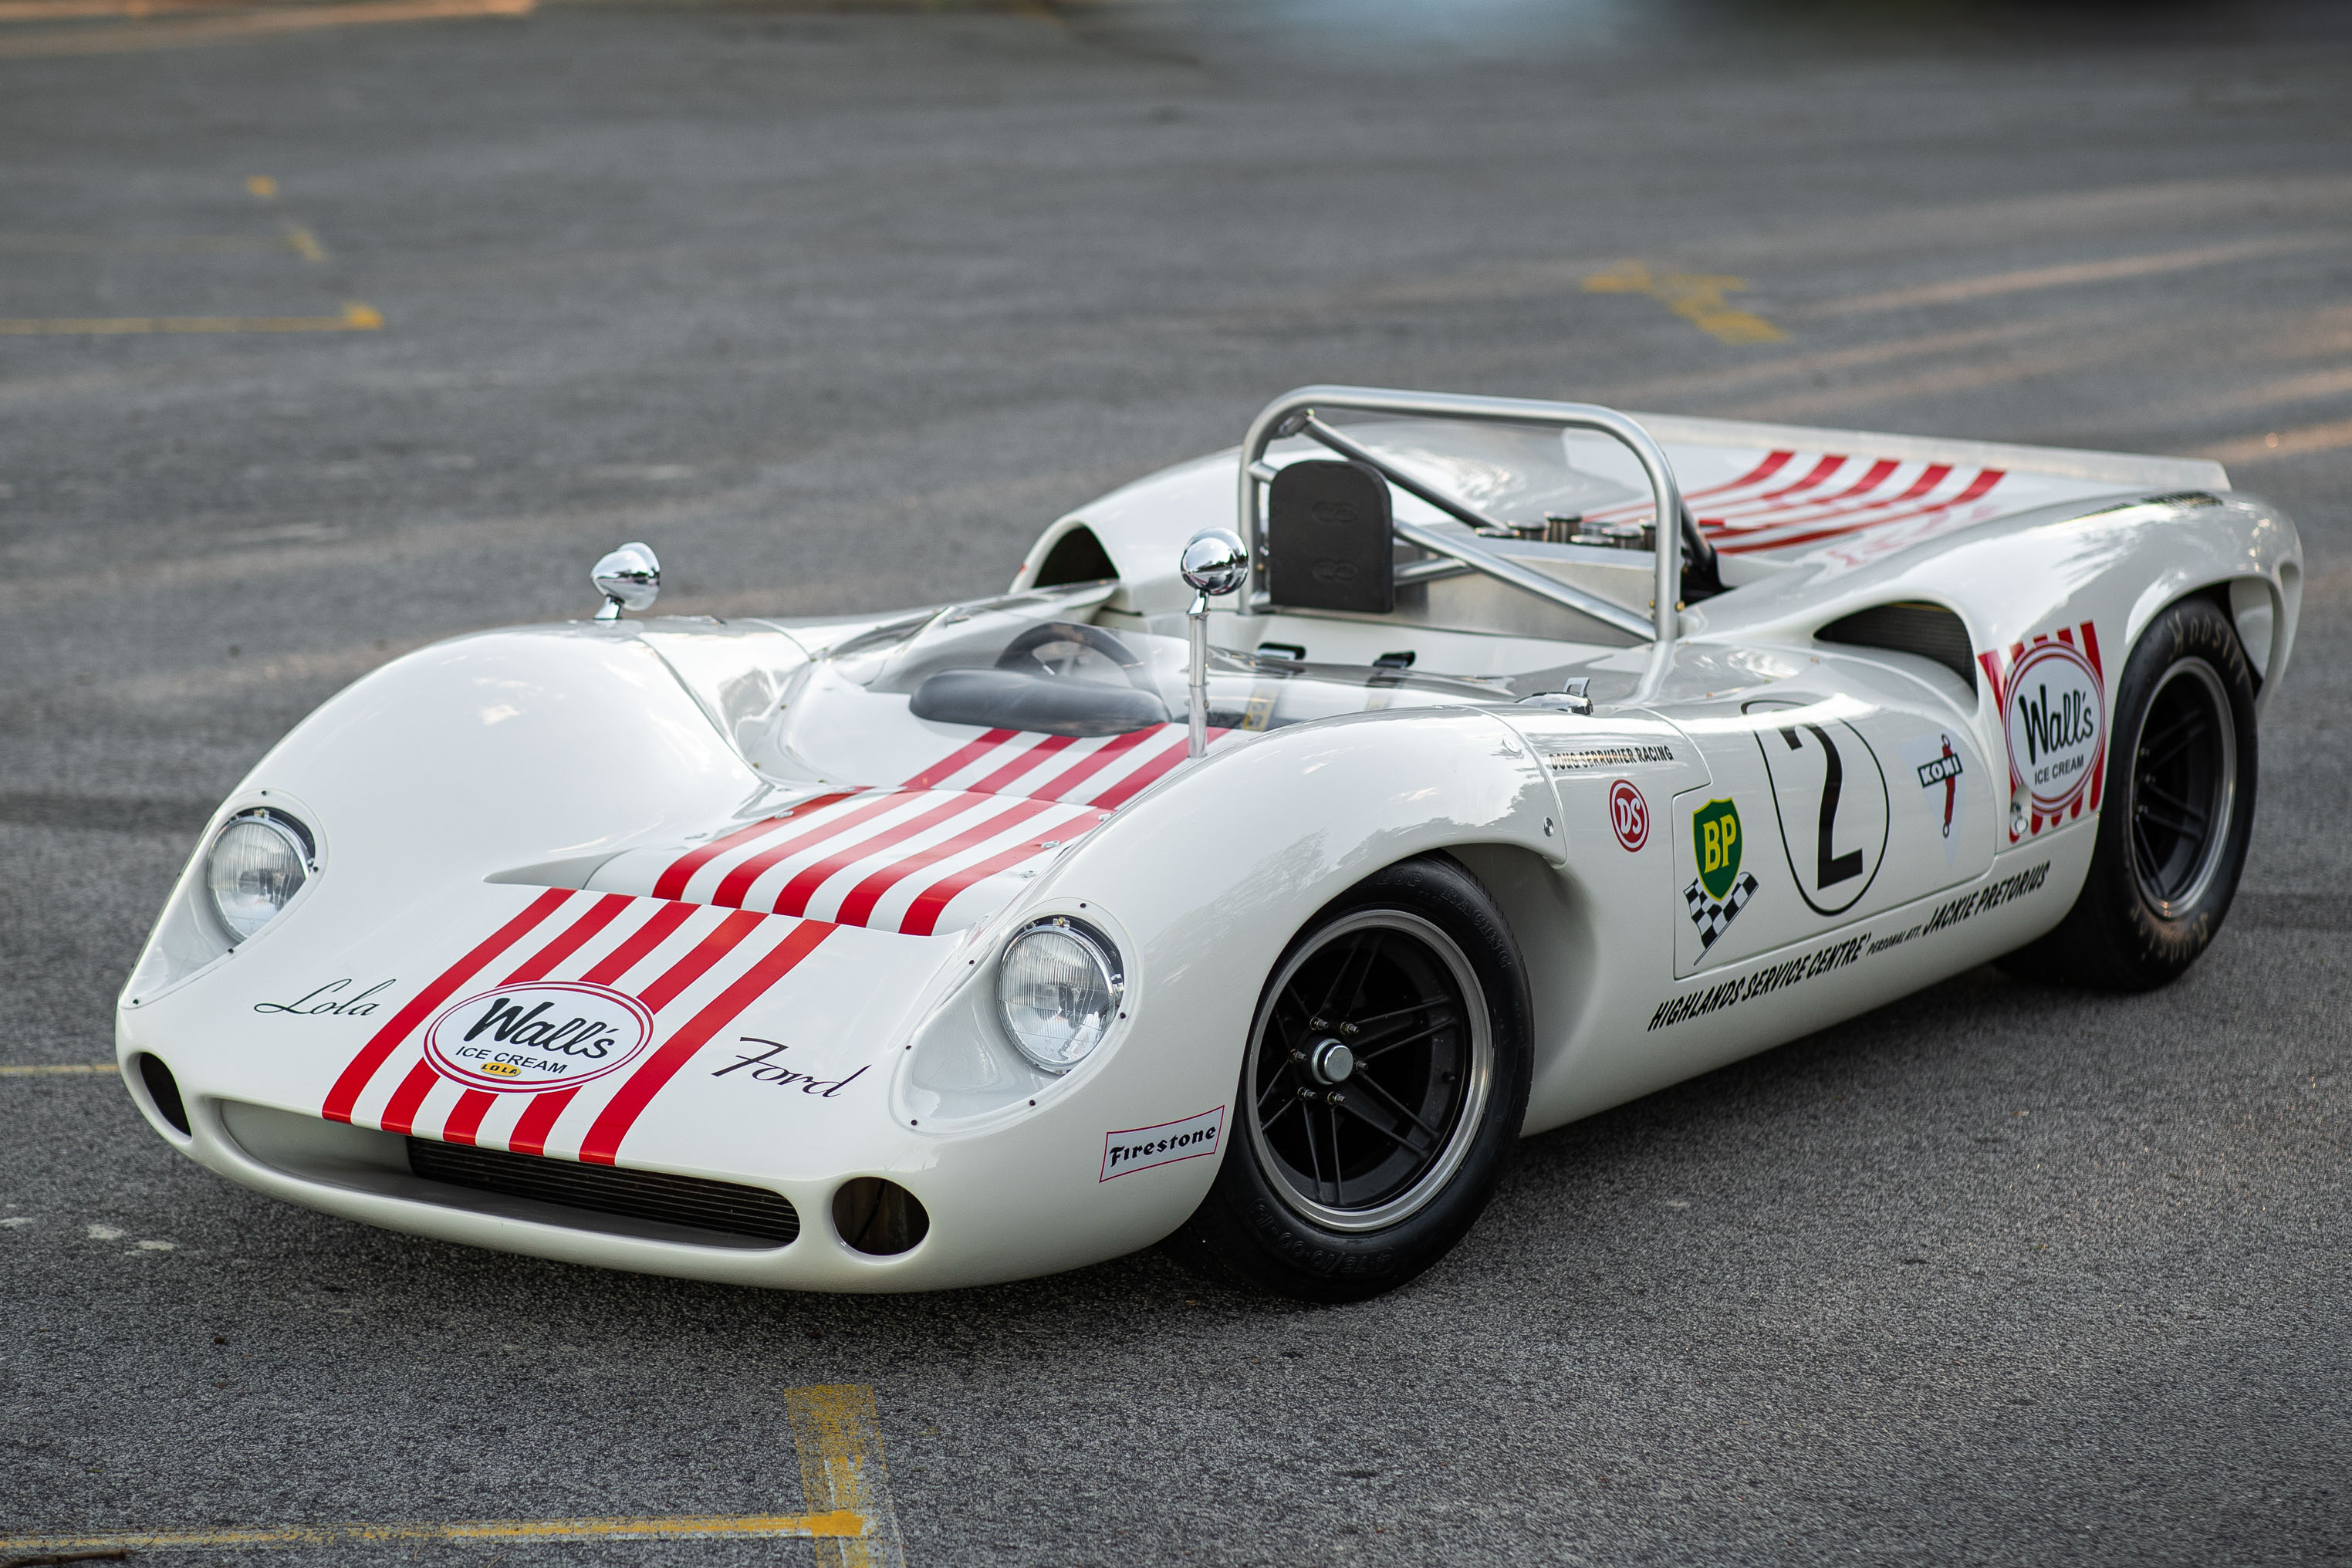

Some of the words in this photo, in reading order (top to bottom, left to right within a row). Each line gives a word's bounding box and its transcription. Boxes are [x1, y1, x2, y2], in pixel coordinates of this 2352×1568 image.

[2018, 684, 2093, 766] Wall's
[1579, 747, 1637, 768] SERRURIER
[1634, 745, 1674, 762] RACING
[1919, 756, 1961, 786] KONI
[2034, 766, 2050, 786] ICE
[2052, 755, 2084, 779] CREAM
[1617, 797, 1642, 834] DS
[1779, 722, 1863, 890] 2
[1703, 814, 1737, 874] BP
[1647, 976, 1745, 1032] HIGHLANDS
[1742, 953, 1812, 1002] SERVICE
[1922, 890, 1979, 937] JACKIE
[1974, 860, 2050, 916] PRETORIUS
[253, 978, 397, 1016] Lola
[463, 997, 620, 1059] Wall's
[455, 1046, 492, 1059] ICE
[493, 1053, 568, 1074] CREAM
[481, 1063, 519, 1075] LOLA
[711, 1036, 872, 1097] Ford
[1109, 1126, 1216, 1168] Firestone
